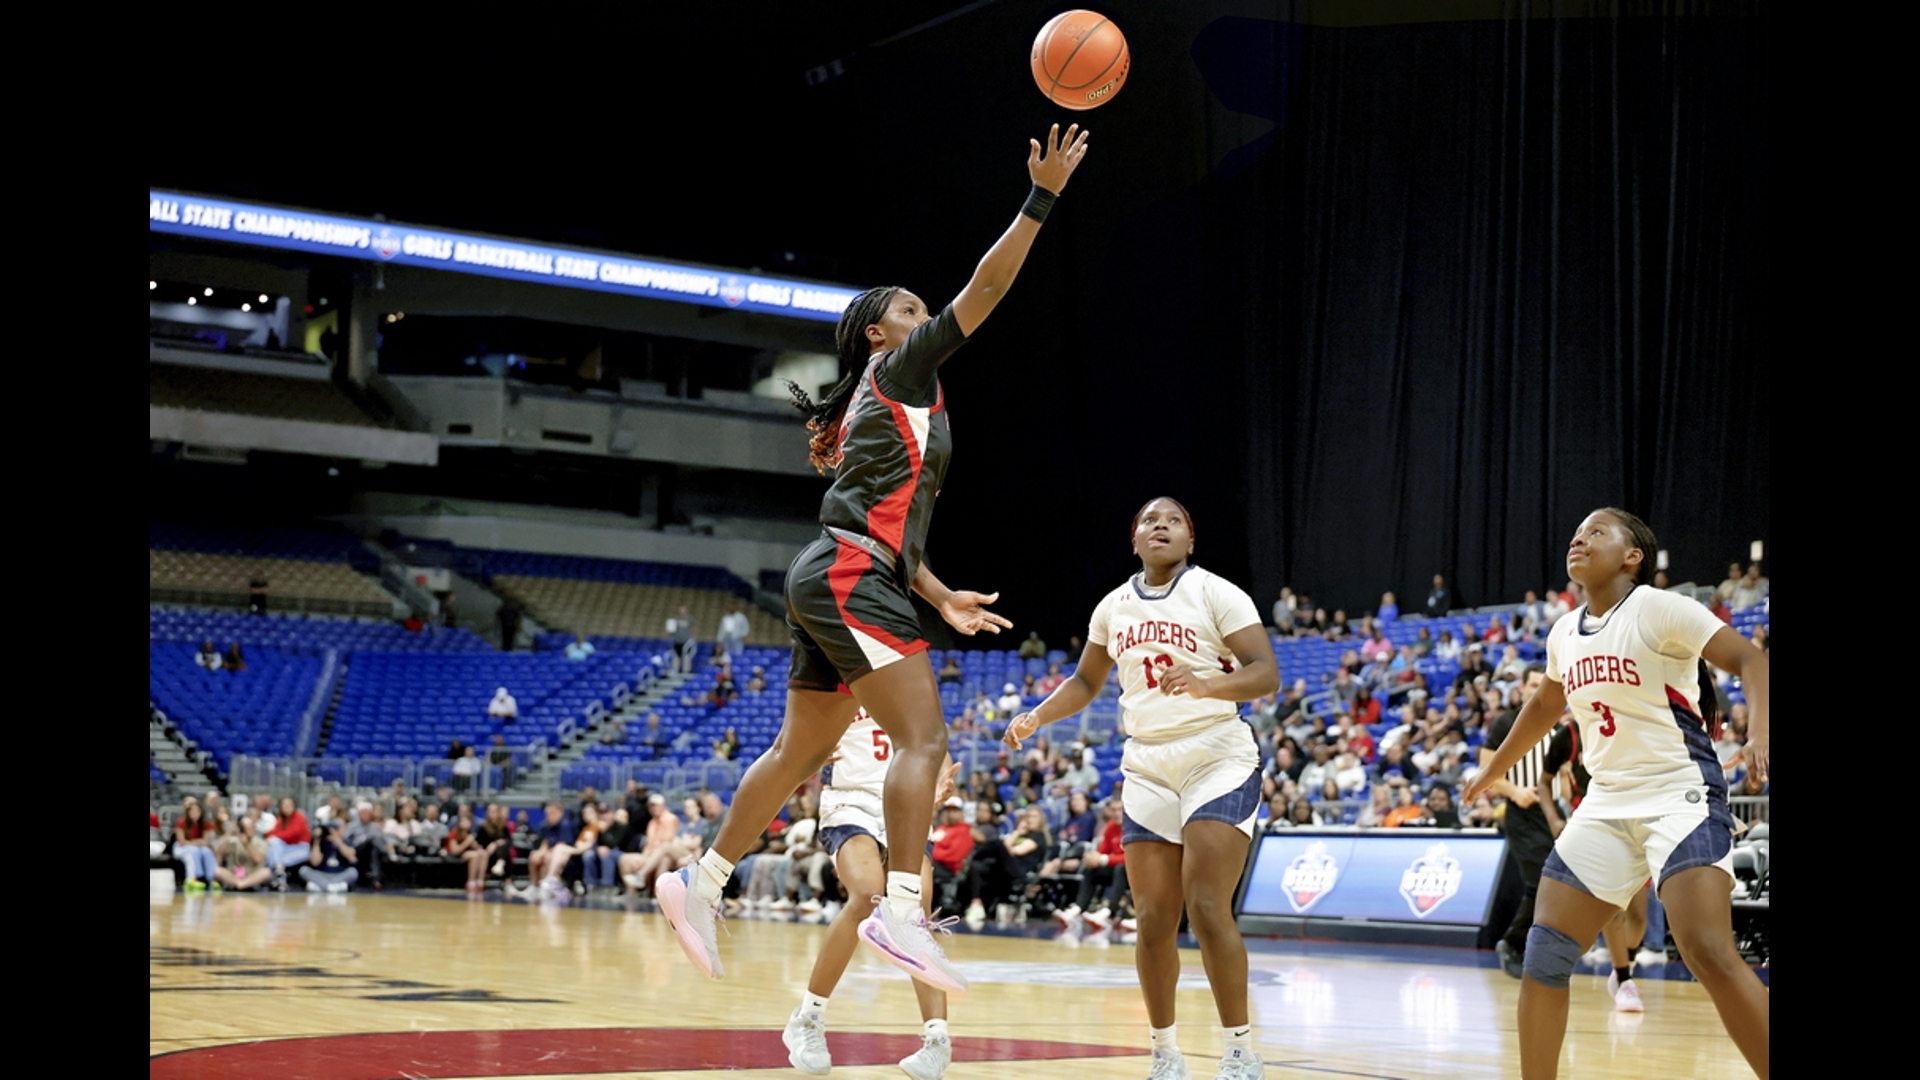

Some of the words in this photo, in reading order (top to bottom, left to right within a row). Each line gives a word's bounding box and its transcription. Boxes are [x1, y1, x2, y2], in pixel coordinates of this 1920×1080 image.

[182, 203, 232, 230] STATE
[234, 211, 371, 249] CHAMPIONSHIPS
[402, 234, 453, 260] GIRLS
[454, 241, 553, 275] BASKETBALL
[554, 255, 599, 281] STATE
[599, 261, 719, 297] CHAMPIONSHIPS
[747, 282, 791, 306] GIRLS
[1116, 620, 1198, 658] RAIDERS
[1591, 700, 1617, 738] 3
[871, 729, 890, 761] 5
